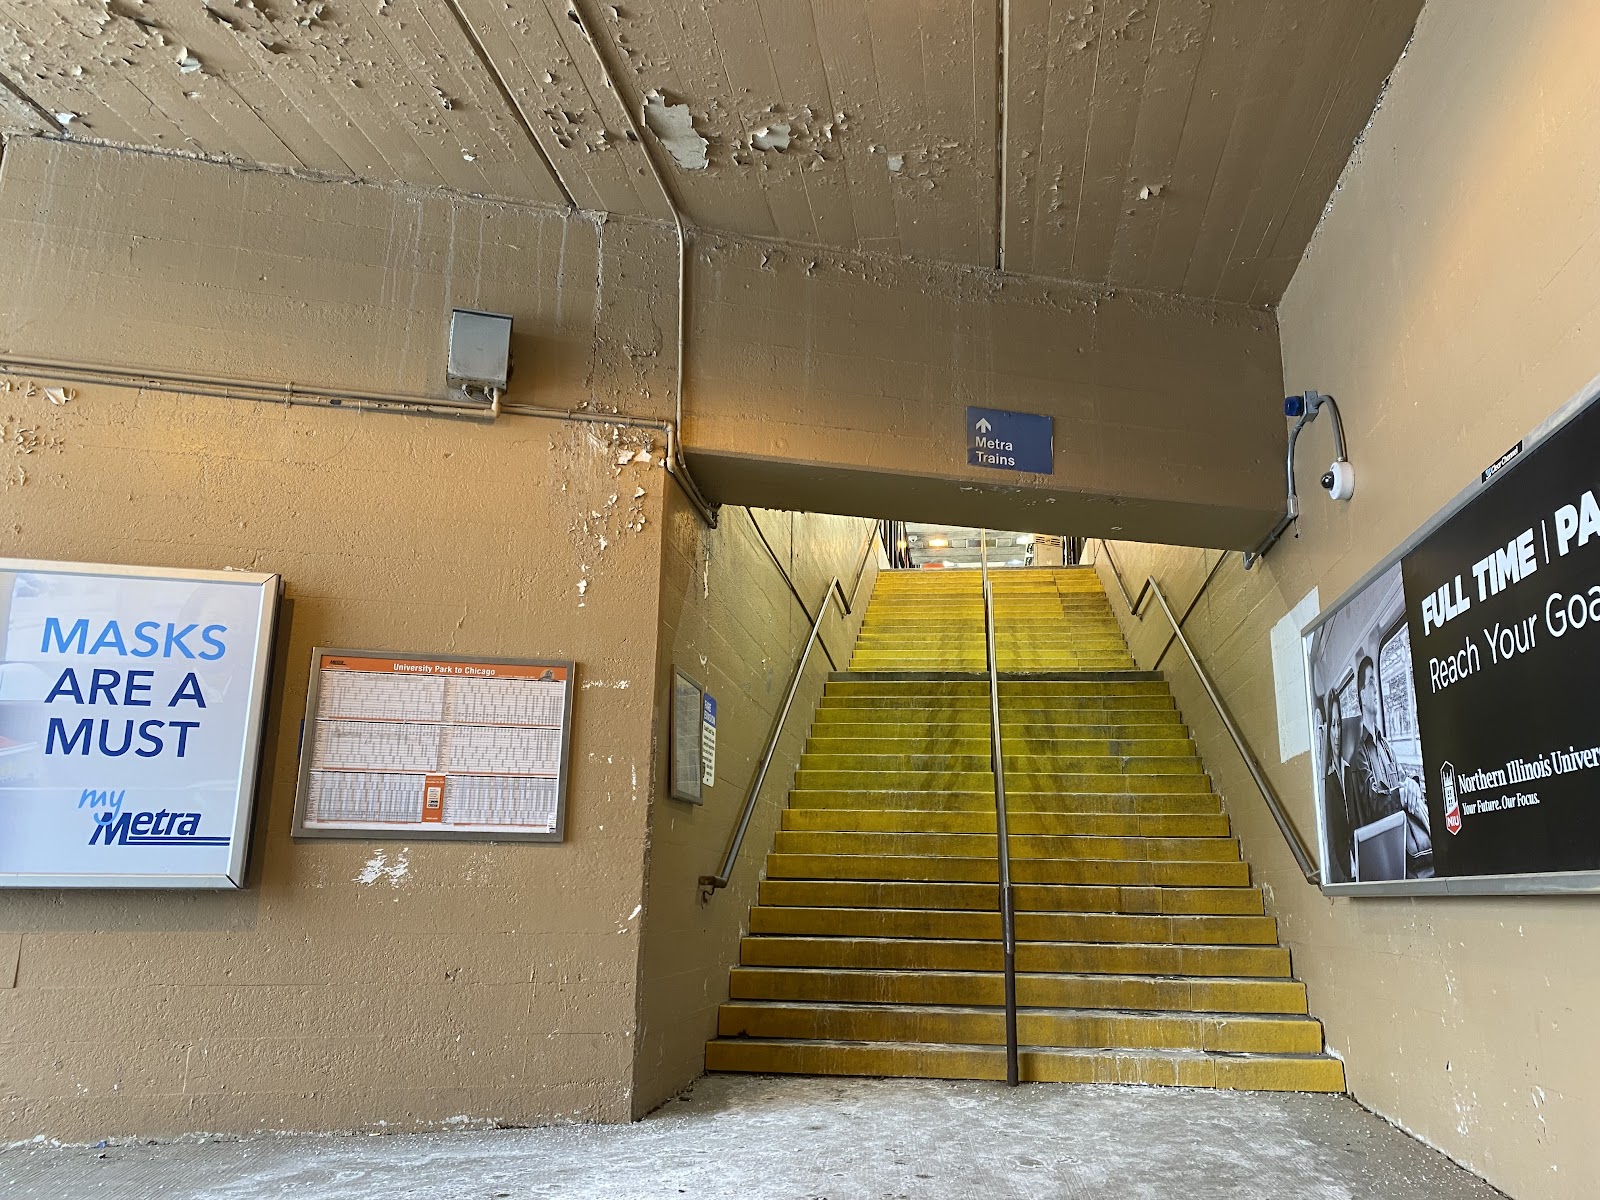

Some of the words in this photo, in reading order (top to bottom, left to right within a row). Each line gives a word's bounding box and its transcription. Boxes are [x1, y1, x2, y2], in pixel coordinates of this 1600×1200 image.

[975, 436, 1013, 451] Metra
[975, 451, 1015, 466] Trains
[1421, 575, 1471, 636] FULL
[1472, 528, 1538, 602] TIME
[40, 617, 228, 661] MASKS
[1429, 636, 1481, 693] Reach
[1483, 614, 1538, 664] Your
[44, 668, 155, 706] ARE
[168, 672, 207, 708] A
[393, 663, 433, 674] University
[434, 665, 453, 674] Park
[454, 666, 463, 674] to
[464, 666, 496, 677] Chicago
[45, 717, 200, 757] MUST
[1458, 768, 1506, 794] Northern
[1506, 753, 1552, 784] Illinois
[1550, 745, 1600, 775] Univer
[78, 788, 126, 824] my
[1447, 815, 1459, 827] NIU
[1462, 802, 1476, 816] Your
[1477, 799, 1502, 813] Future.
[1501, 795, 1516, 810] Our
[1516, 792, 1540, 807] Focus.
[88, 808, 202, 845] Metra
